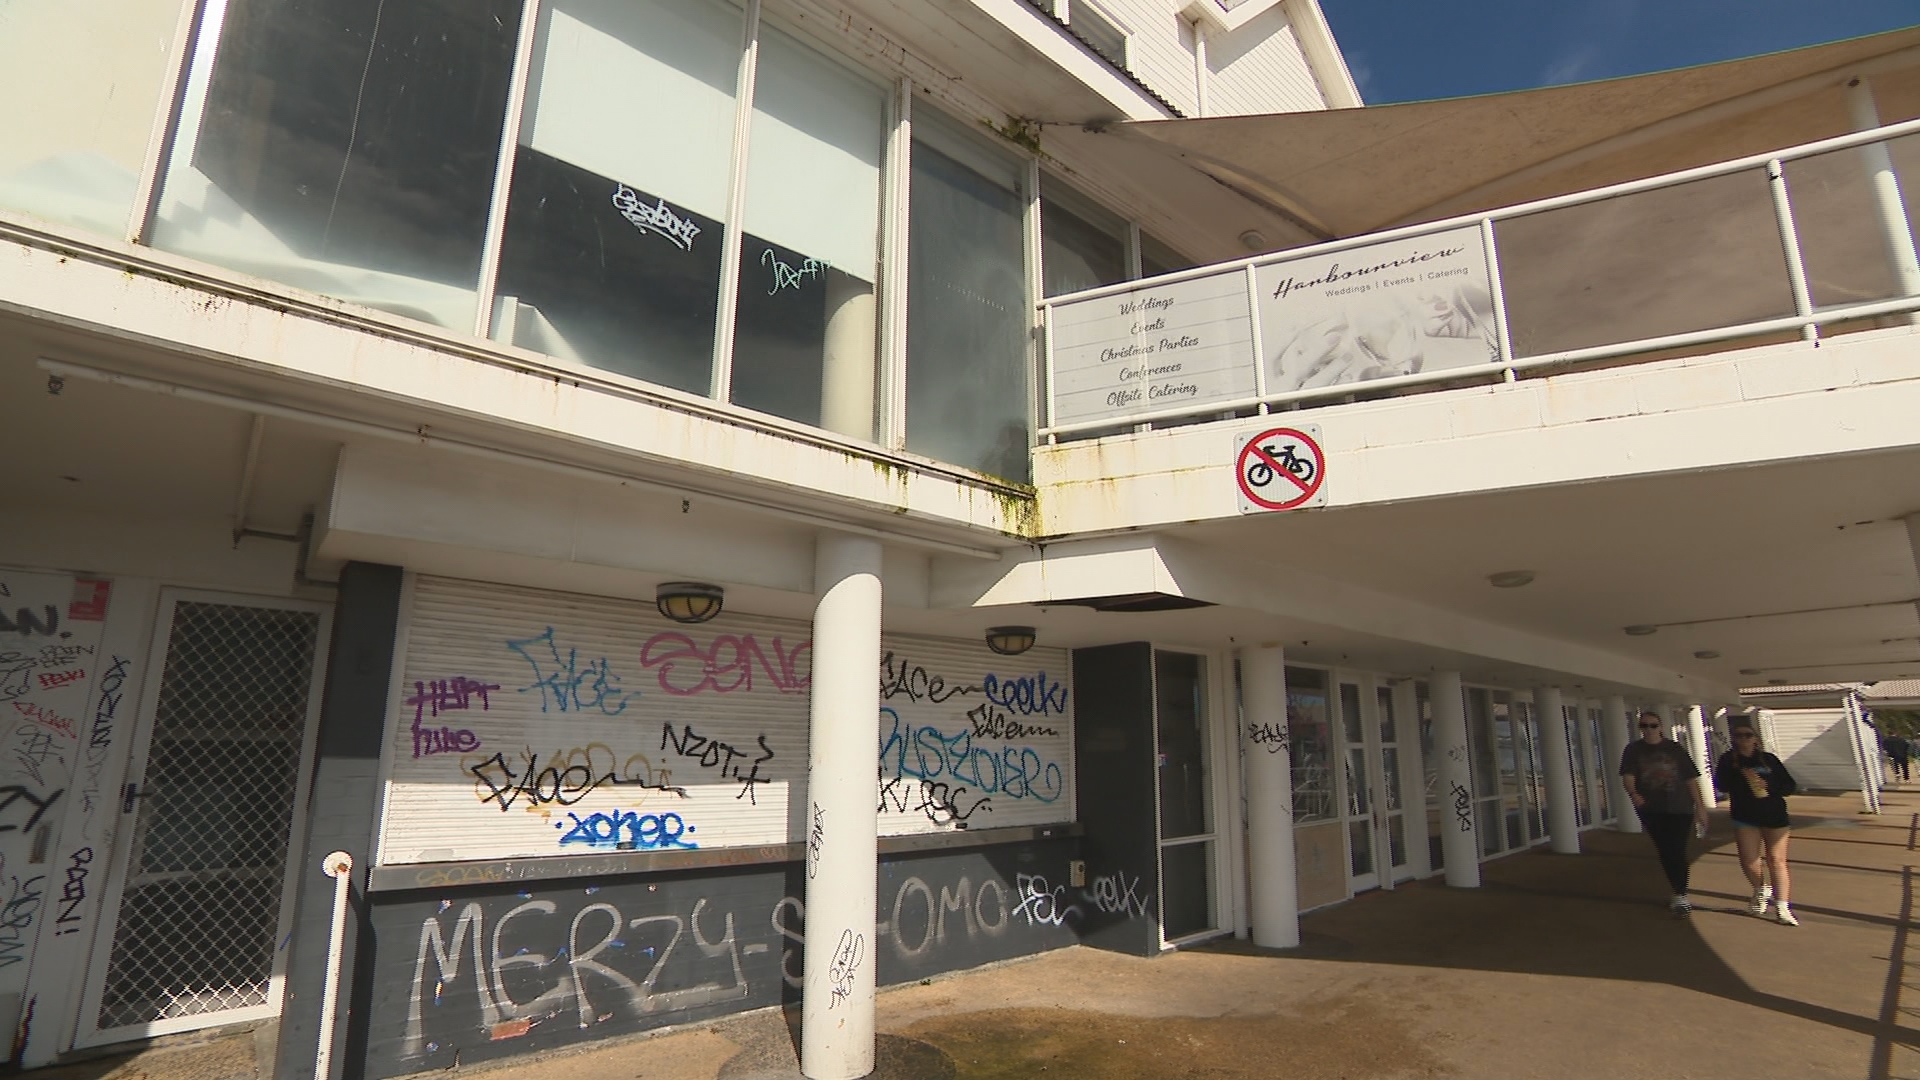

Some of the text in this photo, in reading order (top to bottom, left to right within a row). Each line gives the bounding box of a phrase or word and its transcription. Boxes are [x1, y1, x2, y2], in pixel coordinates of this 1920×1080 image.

[1325, 266, 1469, 298] Weddings Events Catering
[1118, 296, 1174, 316] Weddings
[1130, 317, 1165, 336] Events
[1100, 335, 1199, 363] Christmas Parties
[1119, 362, 1182, 382] Conferences
[1106, 382, 1199, 407] Offsite Catering
